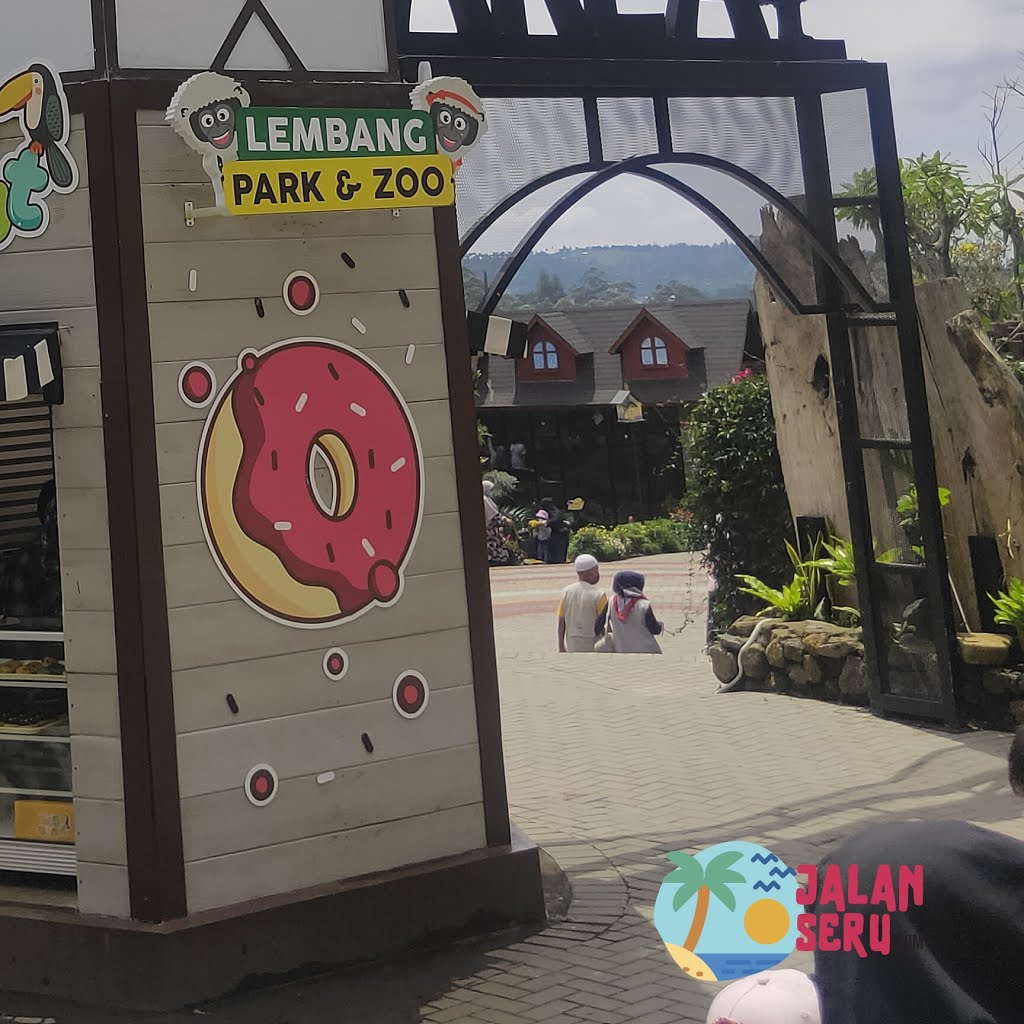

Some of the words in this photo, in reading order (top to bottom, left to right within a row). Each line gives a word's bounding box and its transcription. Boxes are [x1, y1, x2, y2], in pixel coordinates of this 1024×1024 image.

[245, 116, 427, 153] LEMBANG
[233, 171, 324, 206] PARK
[336, 170, 362, 200] &
[373, 166, 445, 198] ZOO
